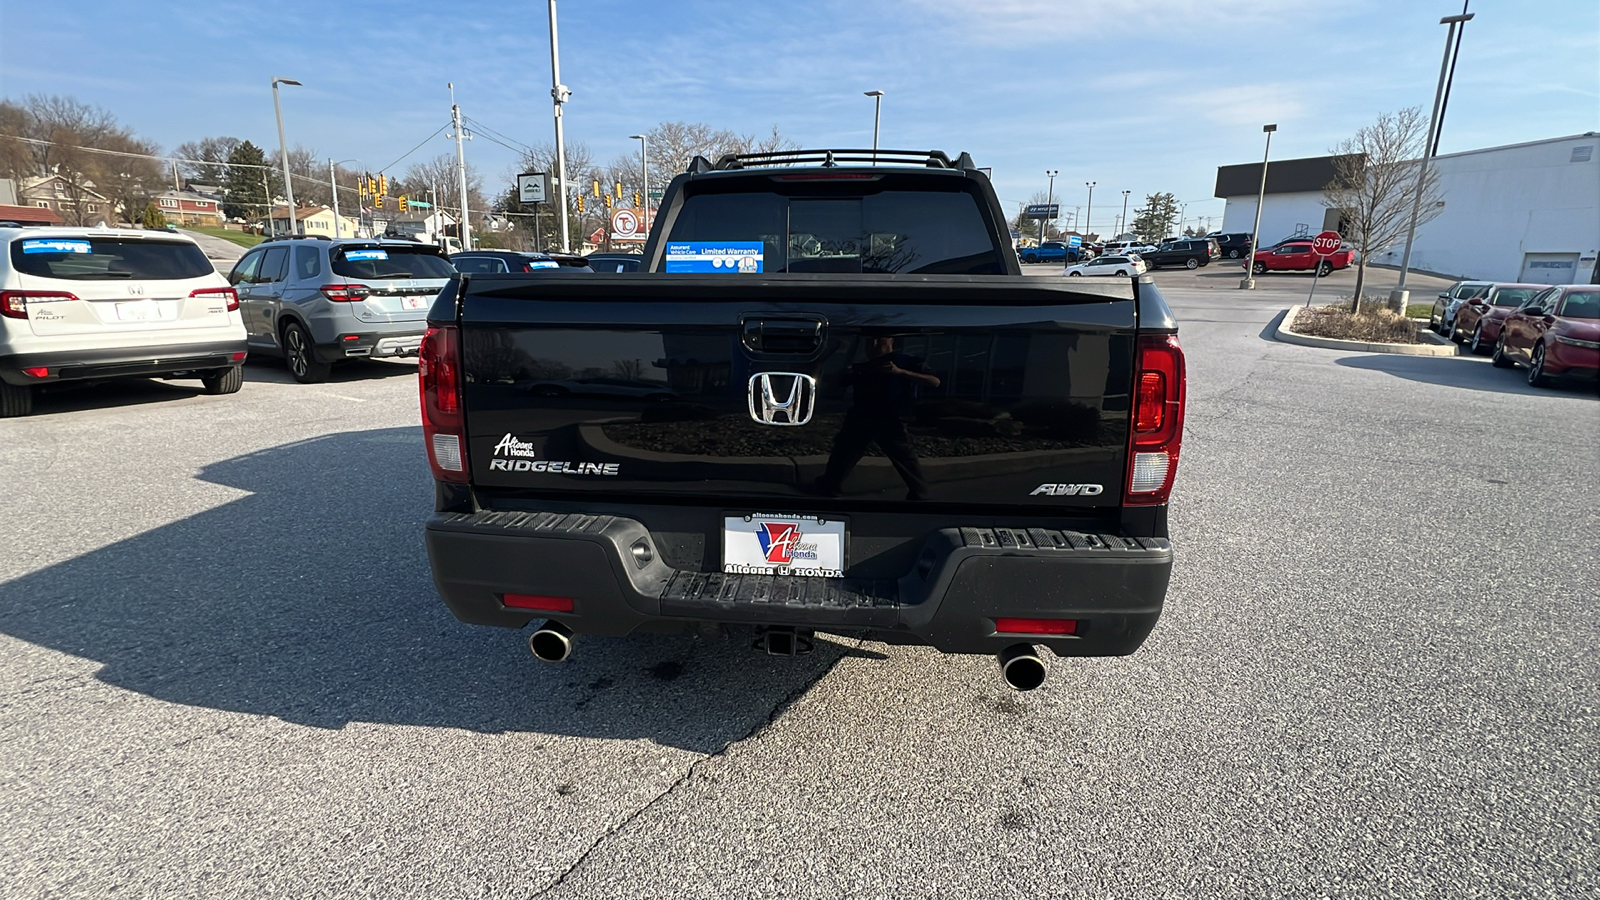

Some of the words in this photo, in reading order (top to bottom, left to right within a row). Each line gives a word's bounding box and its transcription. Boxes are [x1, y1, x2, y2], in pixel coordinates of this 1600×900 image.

[1314, 237, 1340, 248] STOP
[727, 248, 759, 256] Warranty
[493, 432, 534, 456] Altoona
[510, 448, 535, 457] Honda
[489, 458, 620, 476] RIDGELINE
[1029, 483, 1104, 496] AWD
[752, 512, 818, 521] altoonahonda.com
[766, 526, 818, 558] Altoona
[786, 549, 818, 560] Honda
[725, 564, 774, 576] Altoona
[795, 567, 845, 578] HONDA
